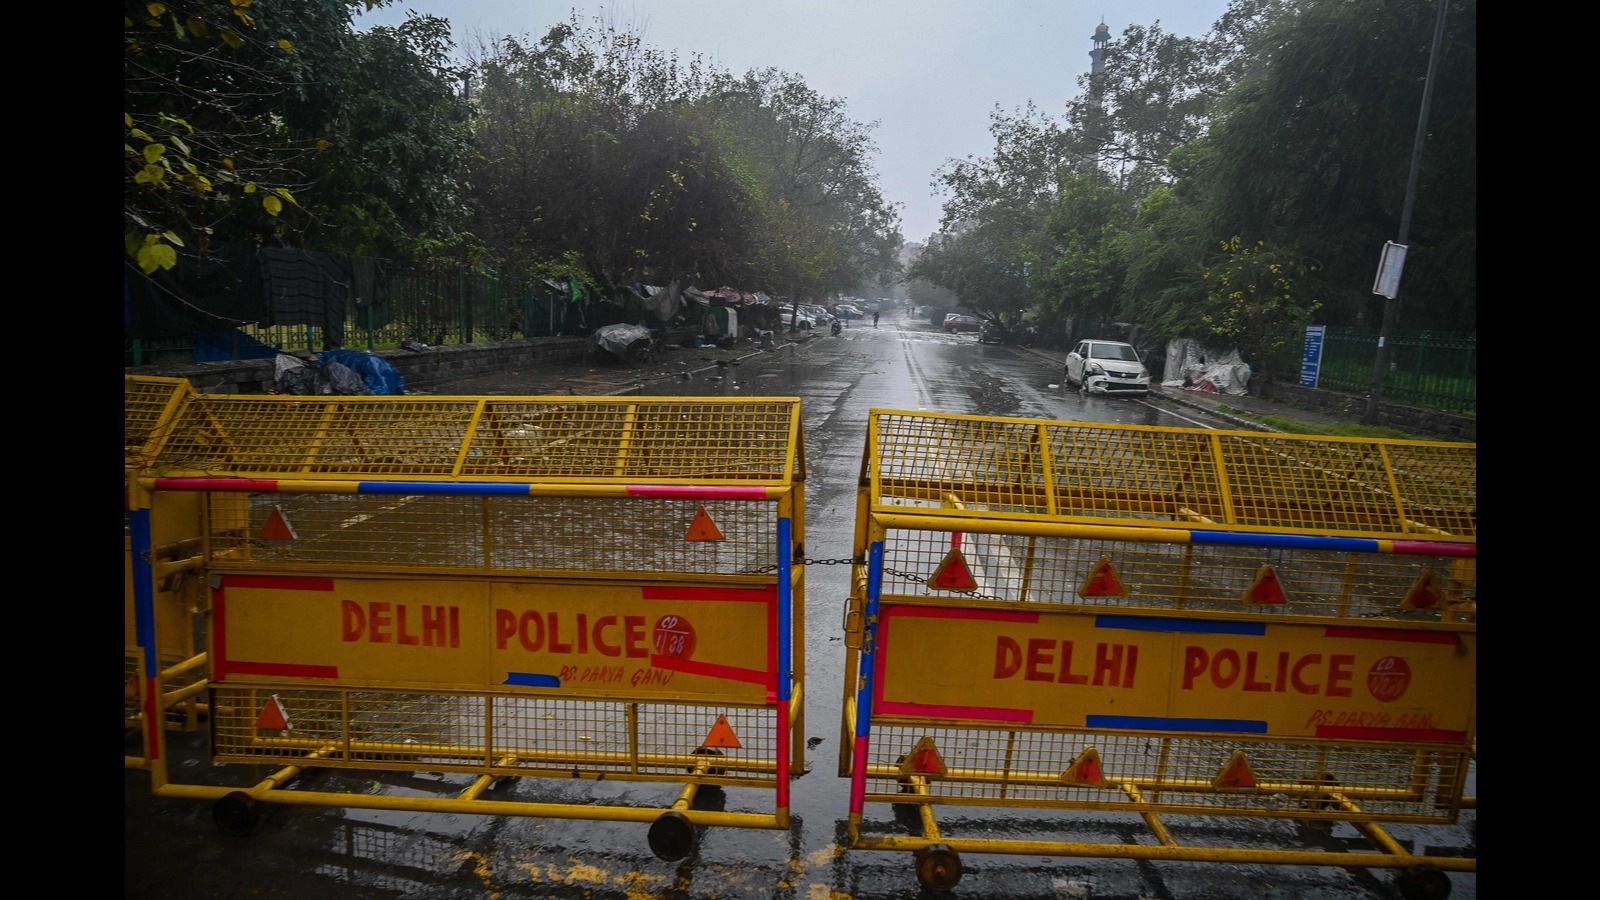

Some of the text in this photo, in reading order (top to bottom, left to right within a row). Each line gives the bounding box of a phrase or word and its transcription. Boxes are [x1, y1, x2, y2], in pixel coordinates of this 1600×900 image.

[342, 600, 649, 658] DELHI POLICE
[661, 616, 678, 629] CD
[580, 665, 625, 685] DARYA
[630, 668, 675, 687] GANJ
[993, 635, 1356, 698] DELHI POLICE
[1333, 711, 1391, 728] DARYA
